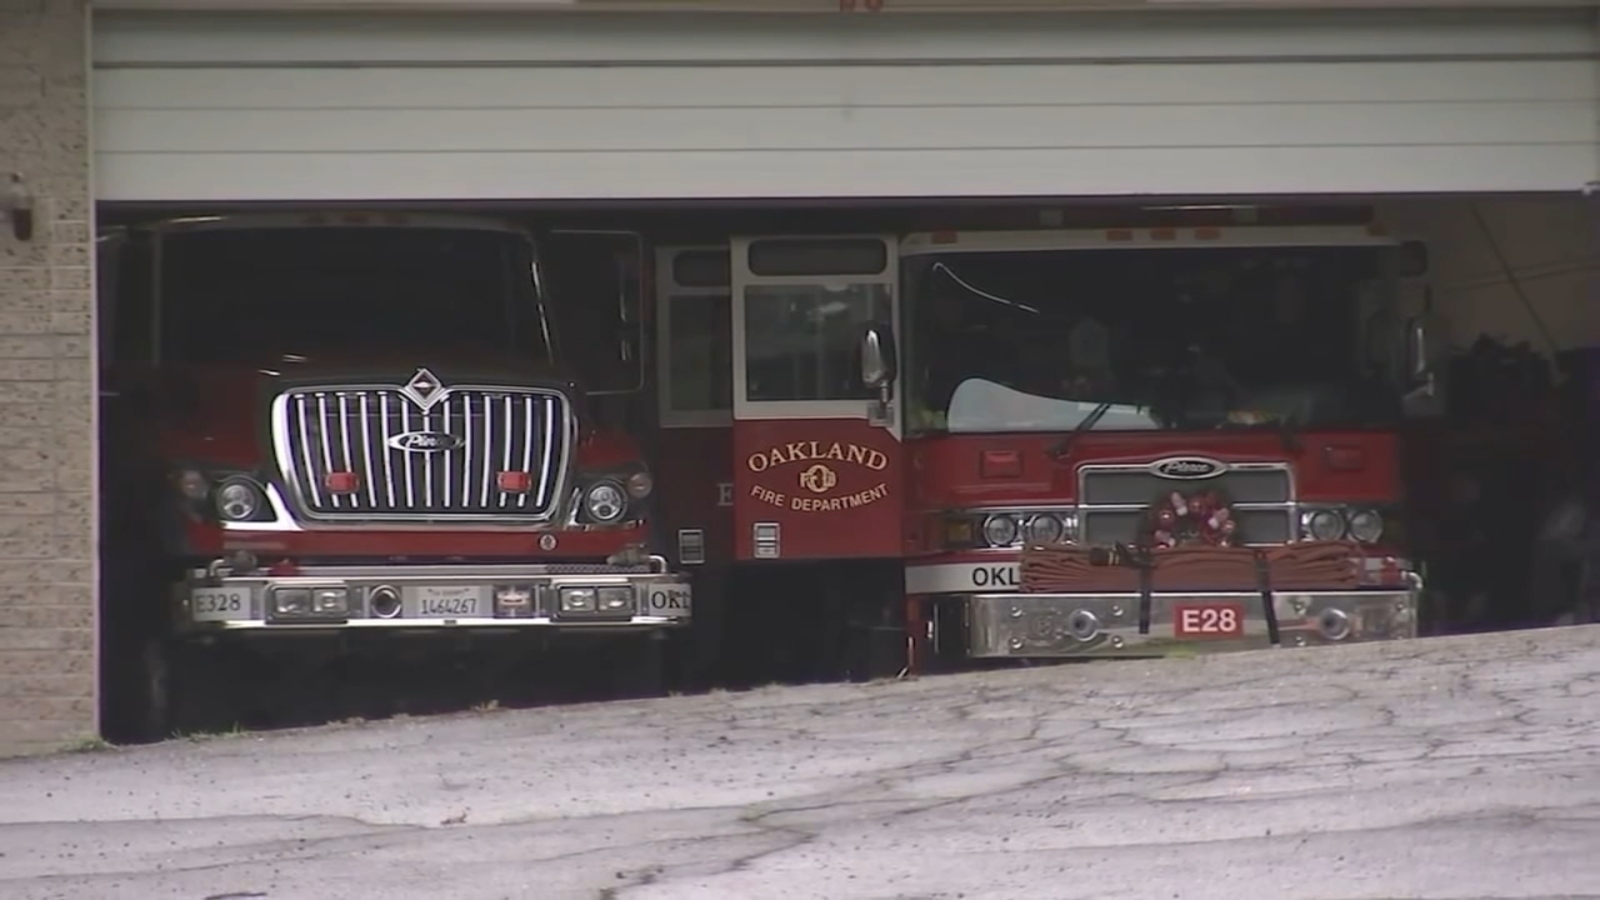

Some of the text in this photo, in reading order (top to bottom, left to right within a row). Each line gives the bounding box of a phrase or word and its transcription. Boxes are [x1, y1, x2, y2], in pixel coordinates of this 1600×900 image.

[404, 433, 455, 448] Pier
[749, 441, 887, 471] OAKLAND
[751, 483, 889, 511] FIRE DEPARTMENT
[972, 567, 1020, 586] OKL
[196, 594, 240, 612] E328
[421, 599, 477, 614] 1464267
[1182, 608, 1237, 632] E28
